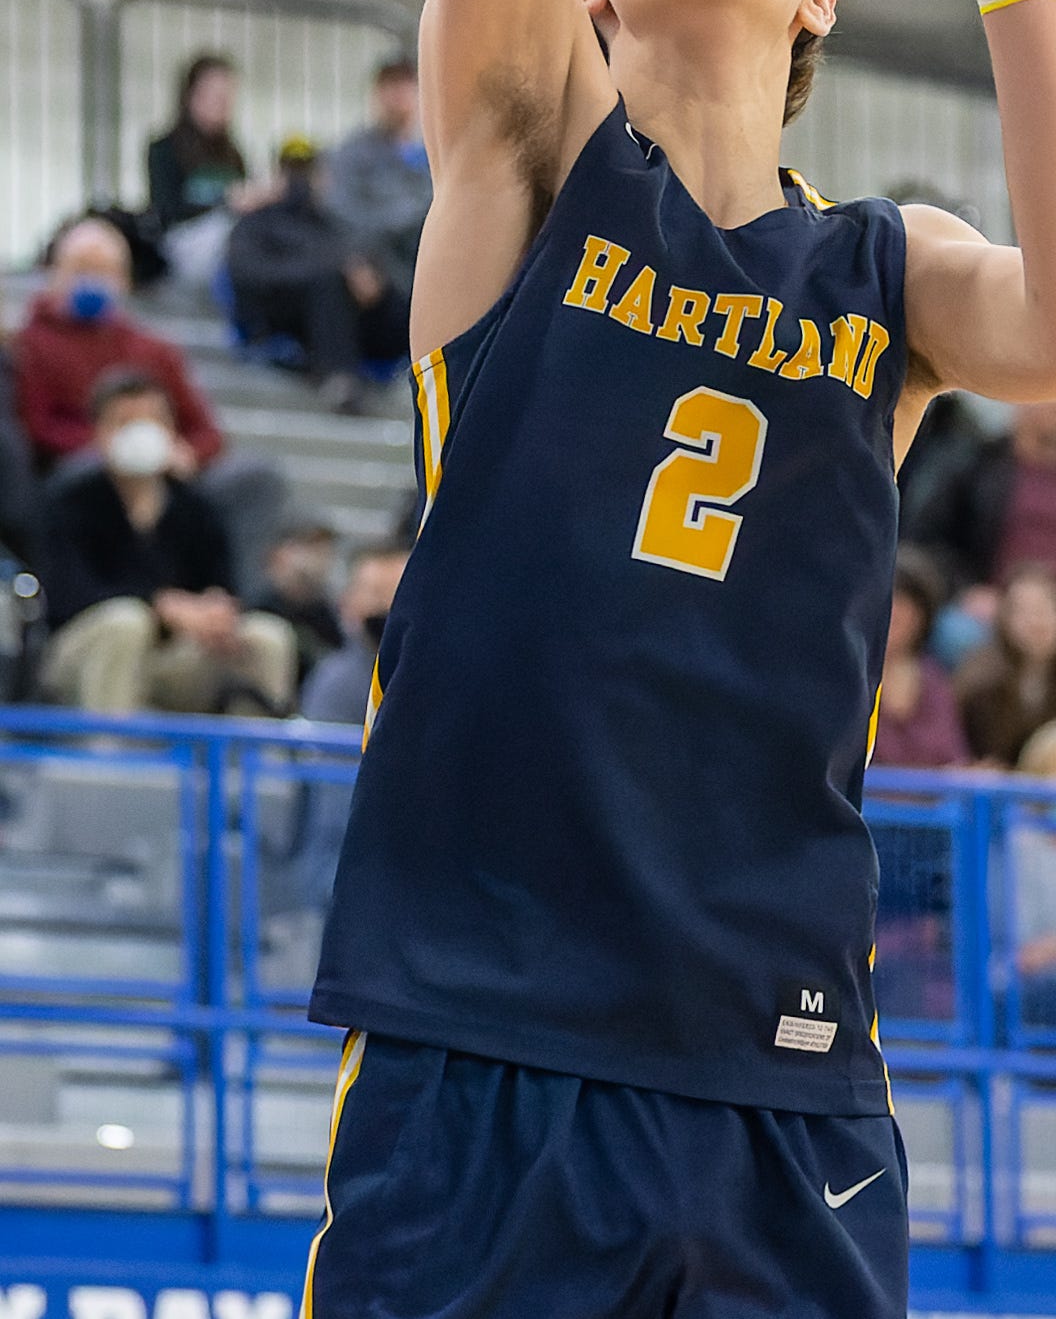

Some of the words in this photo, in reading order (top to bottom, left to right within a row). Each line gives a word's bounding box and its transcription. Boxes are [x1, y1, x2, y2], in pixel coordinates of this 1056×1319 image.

[562, 234, 890, 400] HARTLAND
[631, 385, 769, 582] 2
[800, 989, 825, 1014] M
